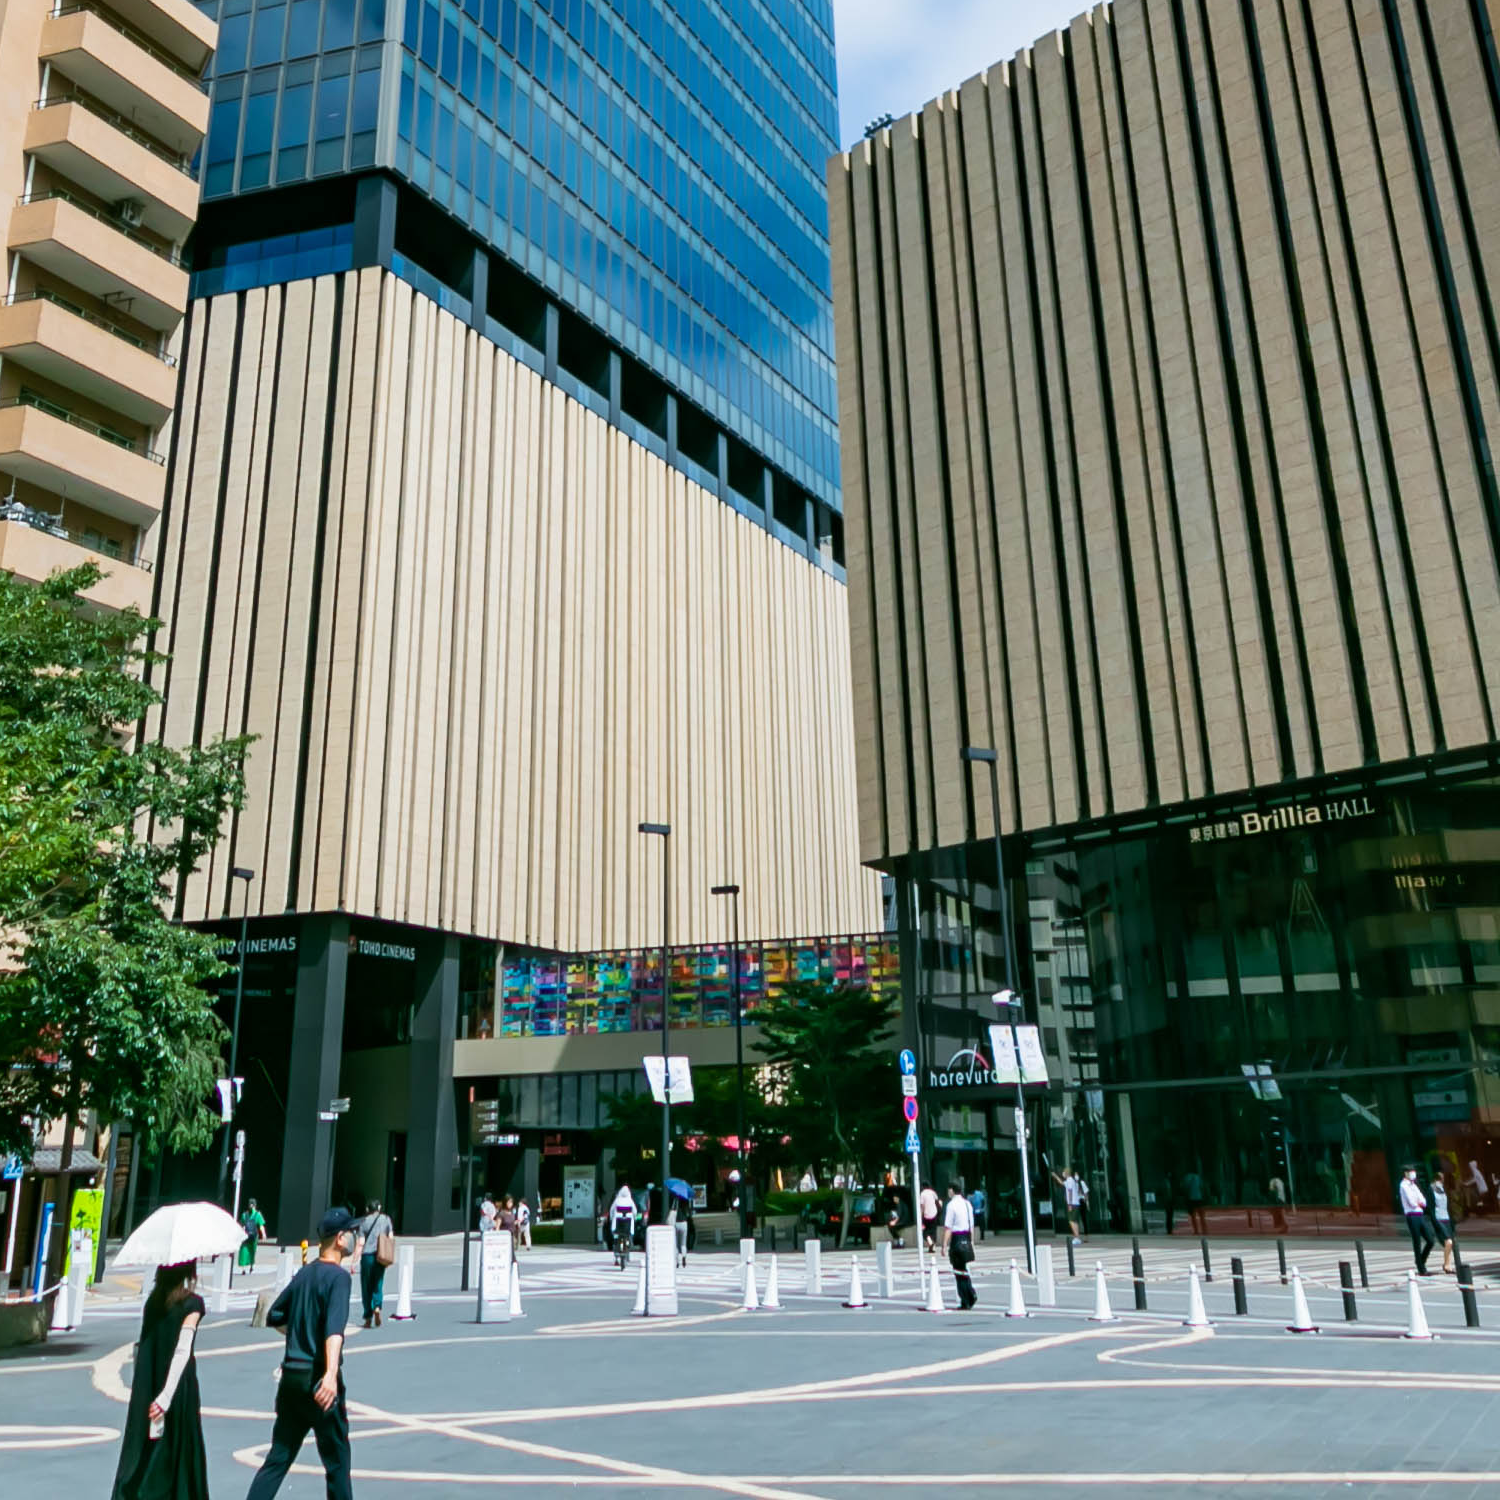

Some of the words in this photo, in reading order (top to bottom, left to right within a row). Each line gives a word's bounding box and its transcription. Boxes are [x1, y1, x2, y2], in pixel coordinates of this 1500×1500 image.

[1241, 804, 1323, 835] Brillia
[1325, 797, 1376, 821] HALL
[1189, 821, 1240, 843] 東京建物
[237, 936, 297, 955] CINEMAS
[359, 939, 381, 956] TOHO
[381, 942, 416, 961] CINEMAS
